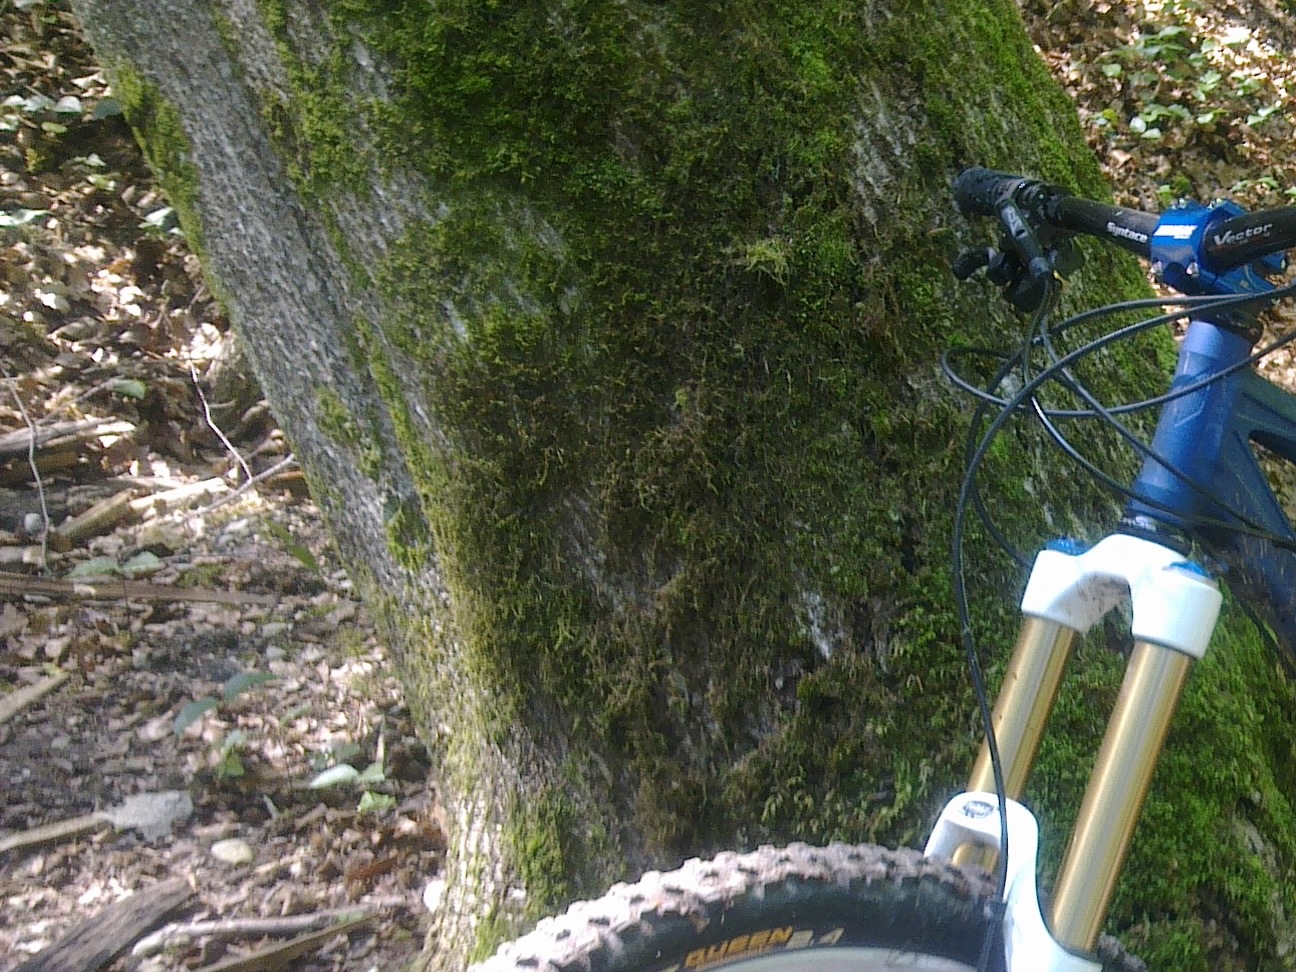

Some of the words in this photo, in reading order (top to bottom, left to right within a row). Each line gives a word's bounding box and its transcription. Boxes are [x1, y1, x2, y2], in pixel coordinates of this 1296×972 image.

[1106, 221, 1148, 244] Syntace
[1213, 223, 1273, 246] Vector
[685, 926, 793, 969] QUEEN
